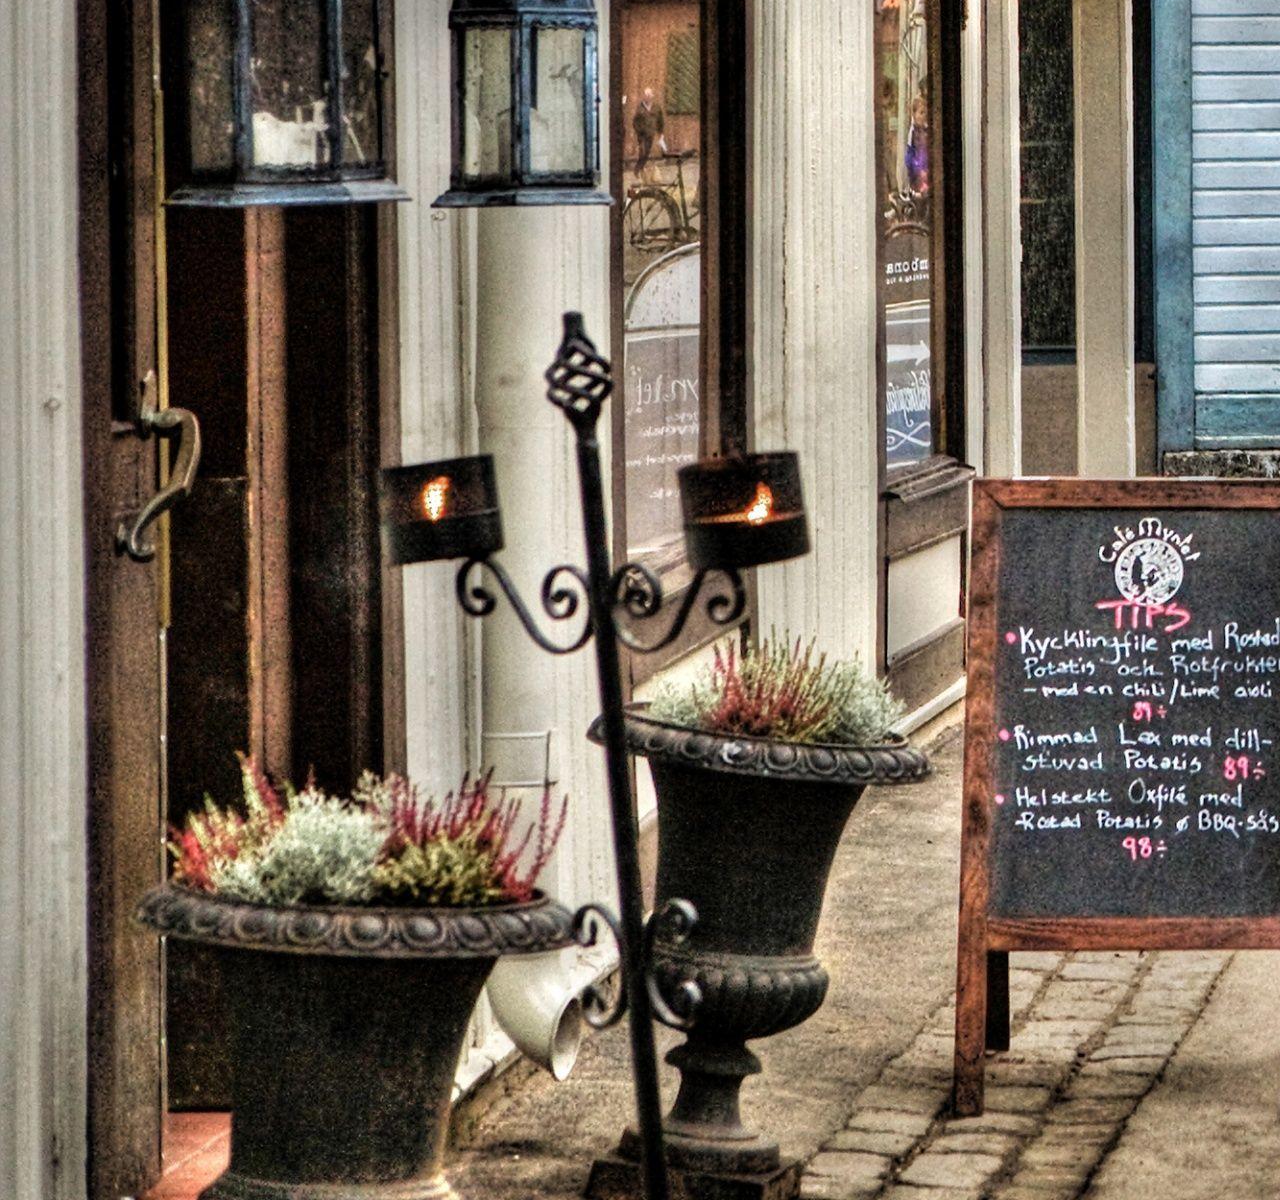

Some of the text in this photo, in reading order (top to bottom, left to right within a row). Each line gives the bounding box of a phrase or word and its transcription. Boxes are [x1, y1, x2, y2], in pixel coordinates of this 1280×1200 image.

[1094, 599, 1191, 632] TIPS
[1172, 630, 1214, 651] med
[1024, 656, 1096, 679] Potatis
[1117, 659, 1164, 677] och
[1042, 680, 1078, 697] med
[1084, 684, 1114, 696] en
[1013, 723, 1273, 752] Rimmad Lax med dill-
[1021, 751, 1104, 772] stuvad
[1123, 749, 1202, 774] Potatis
[1199, 783, 1243, 808] med
[1096, 809, 1163, 830] Potatis
